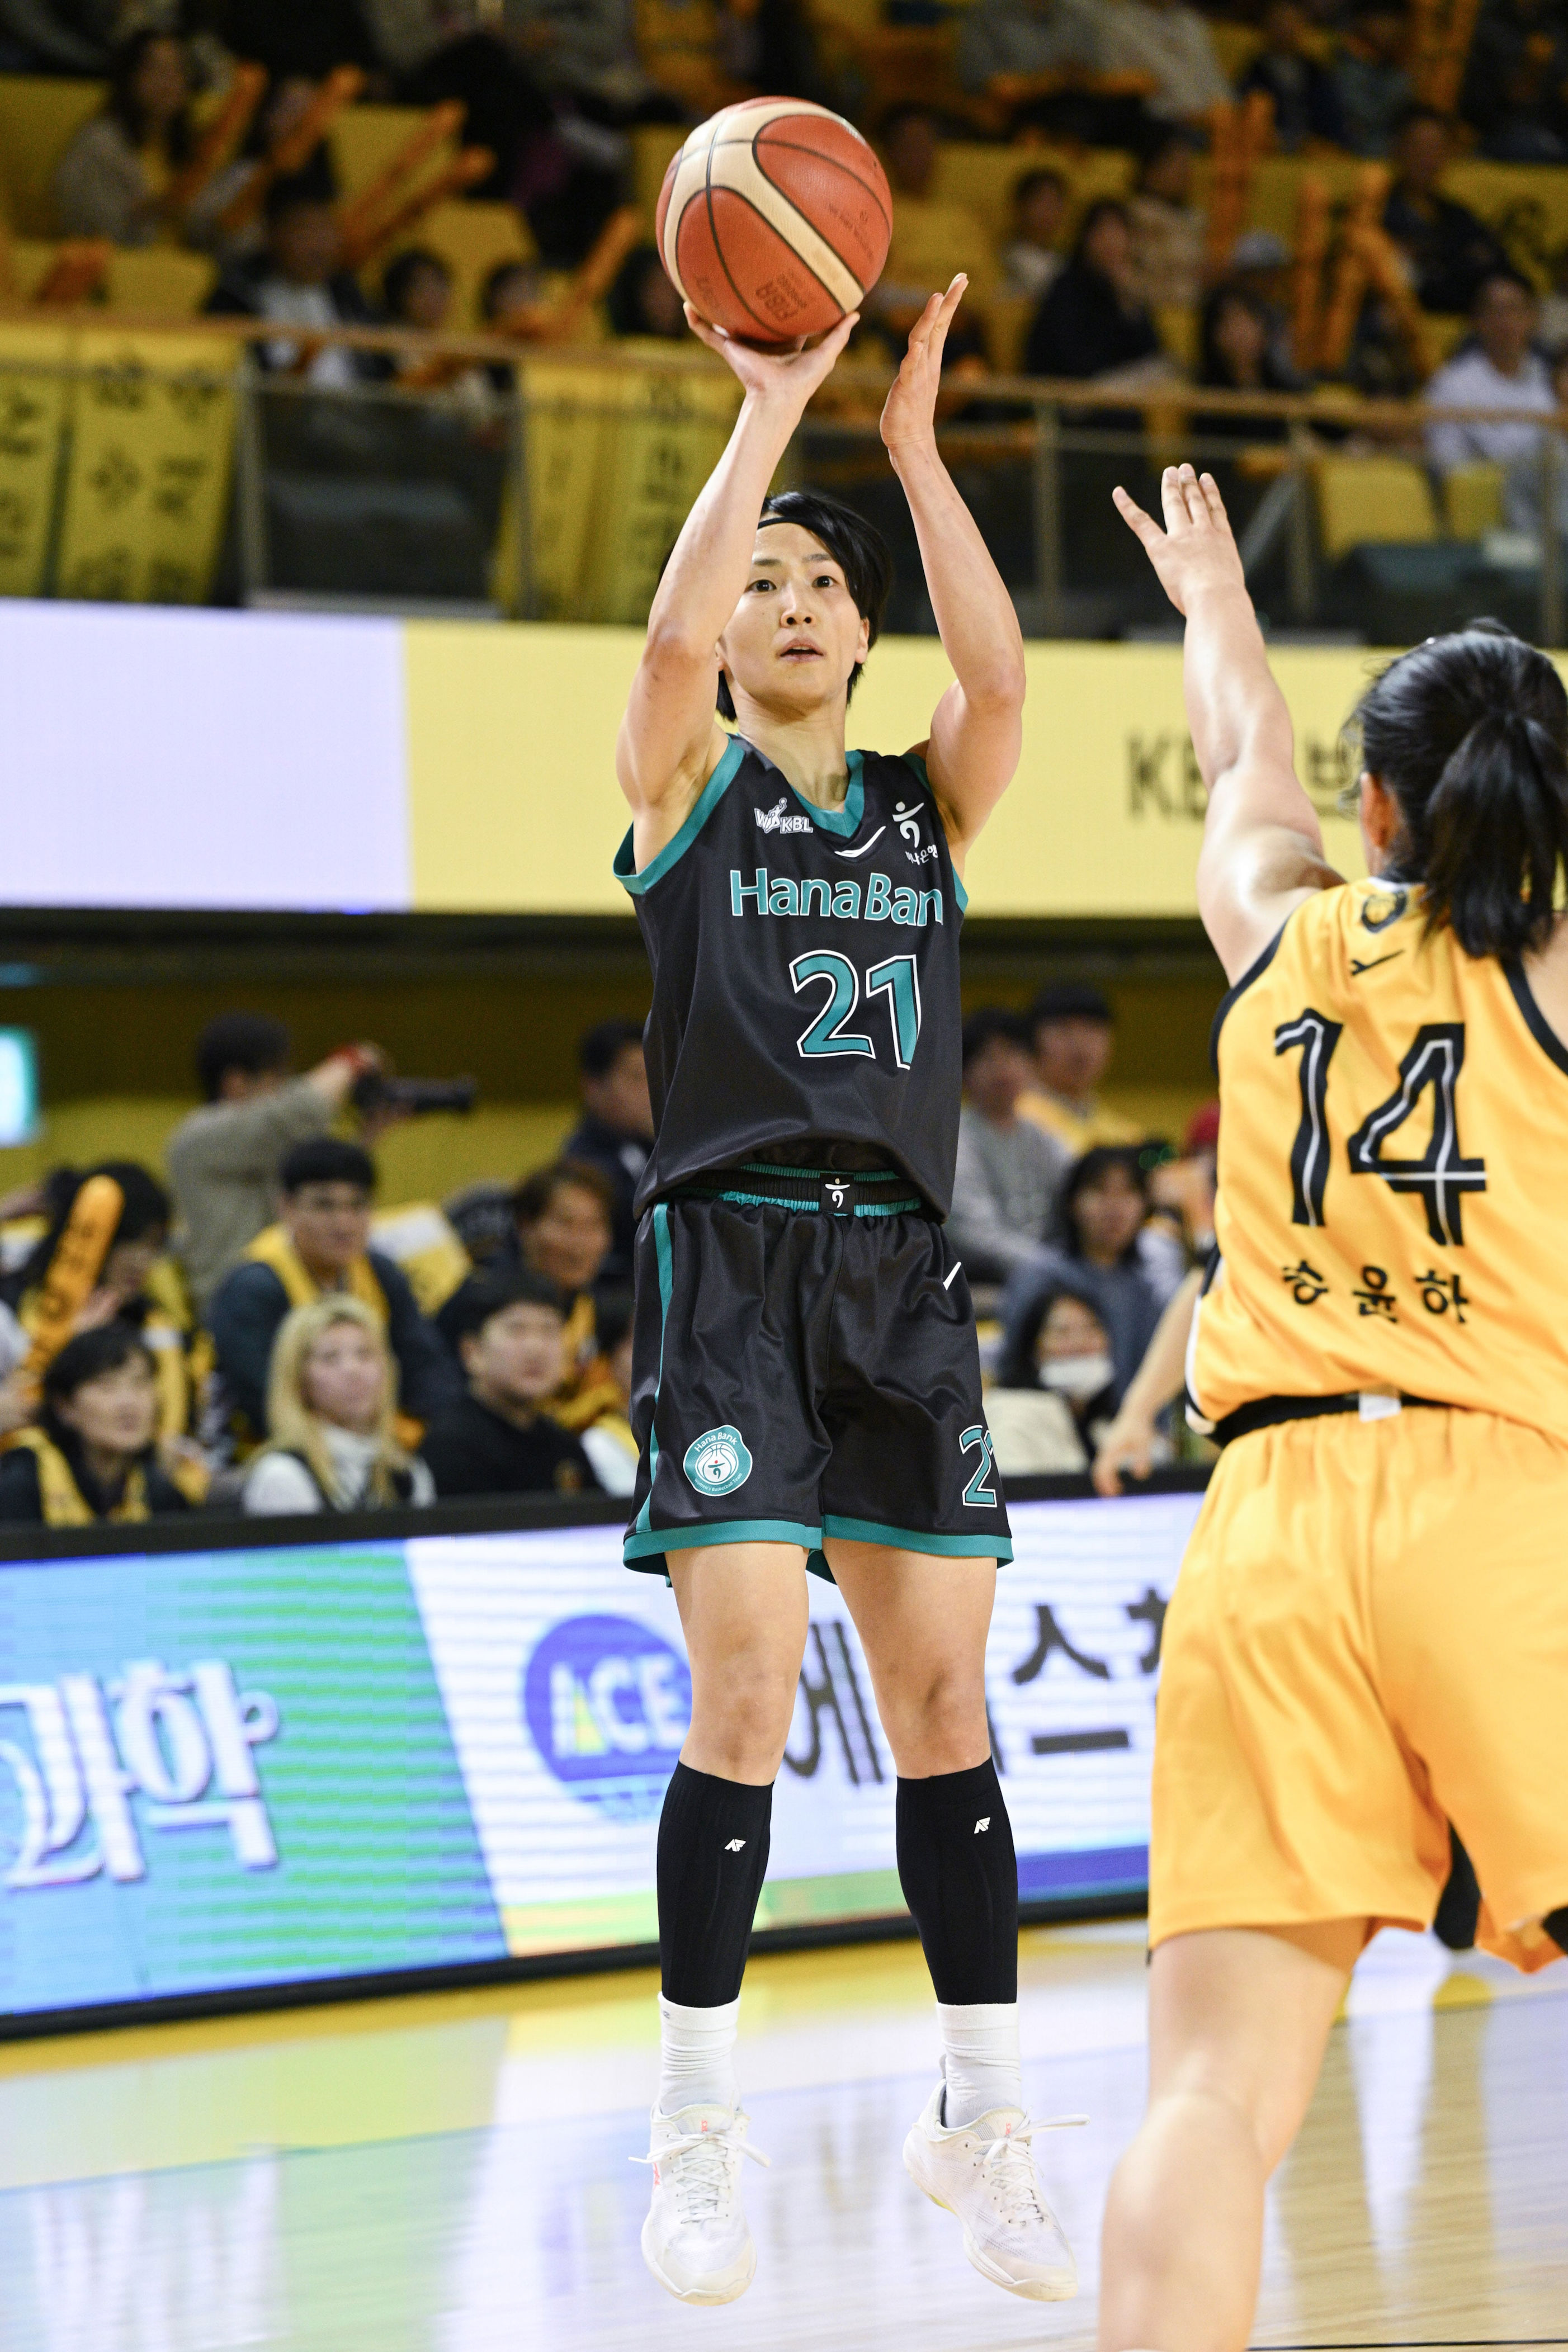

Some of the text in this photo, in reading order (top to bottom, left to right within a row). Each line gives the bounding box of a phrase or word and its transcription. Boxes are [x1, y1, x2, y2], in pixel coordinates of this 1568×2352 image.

[788, 949, 922, 1070] 21
[1274, 1007, 1487, 1247] 14
[694, 1432, 738, 1452] Hana Bank
[711, 1481, 733, 1491] Basketball
[733, 1472, 743, 1483] Team
[550, 1653, 690, 1759] ACE
